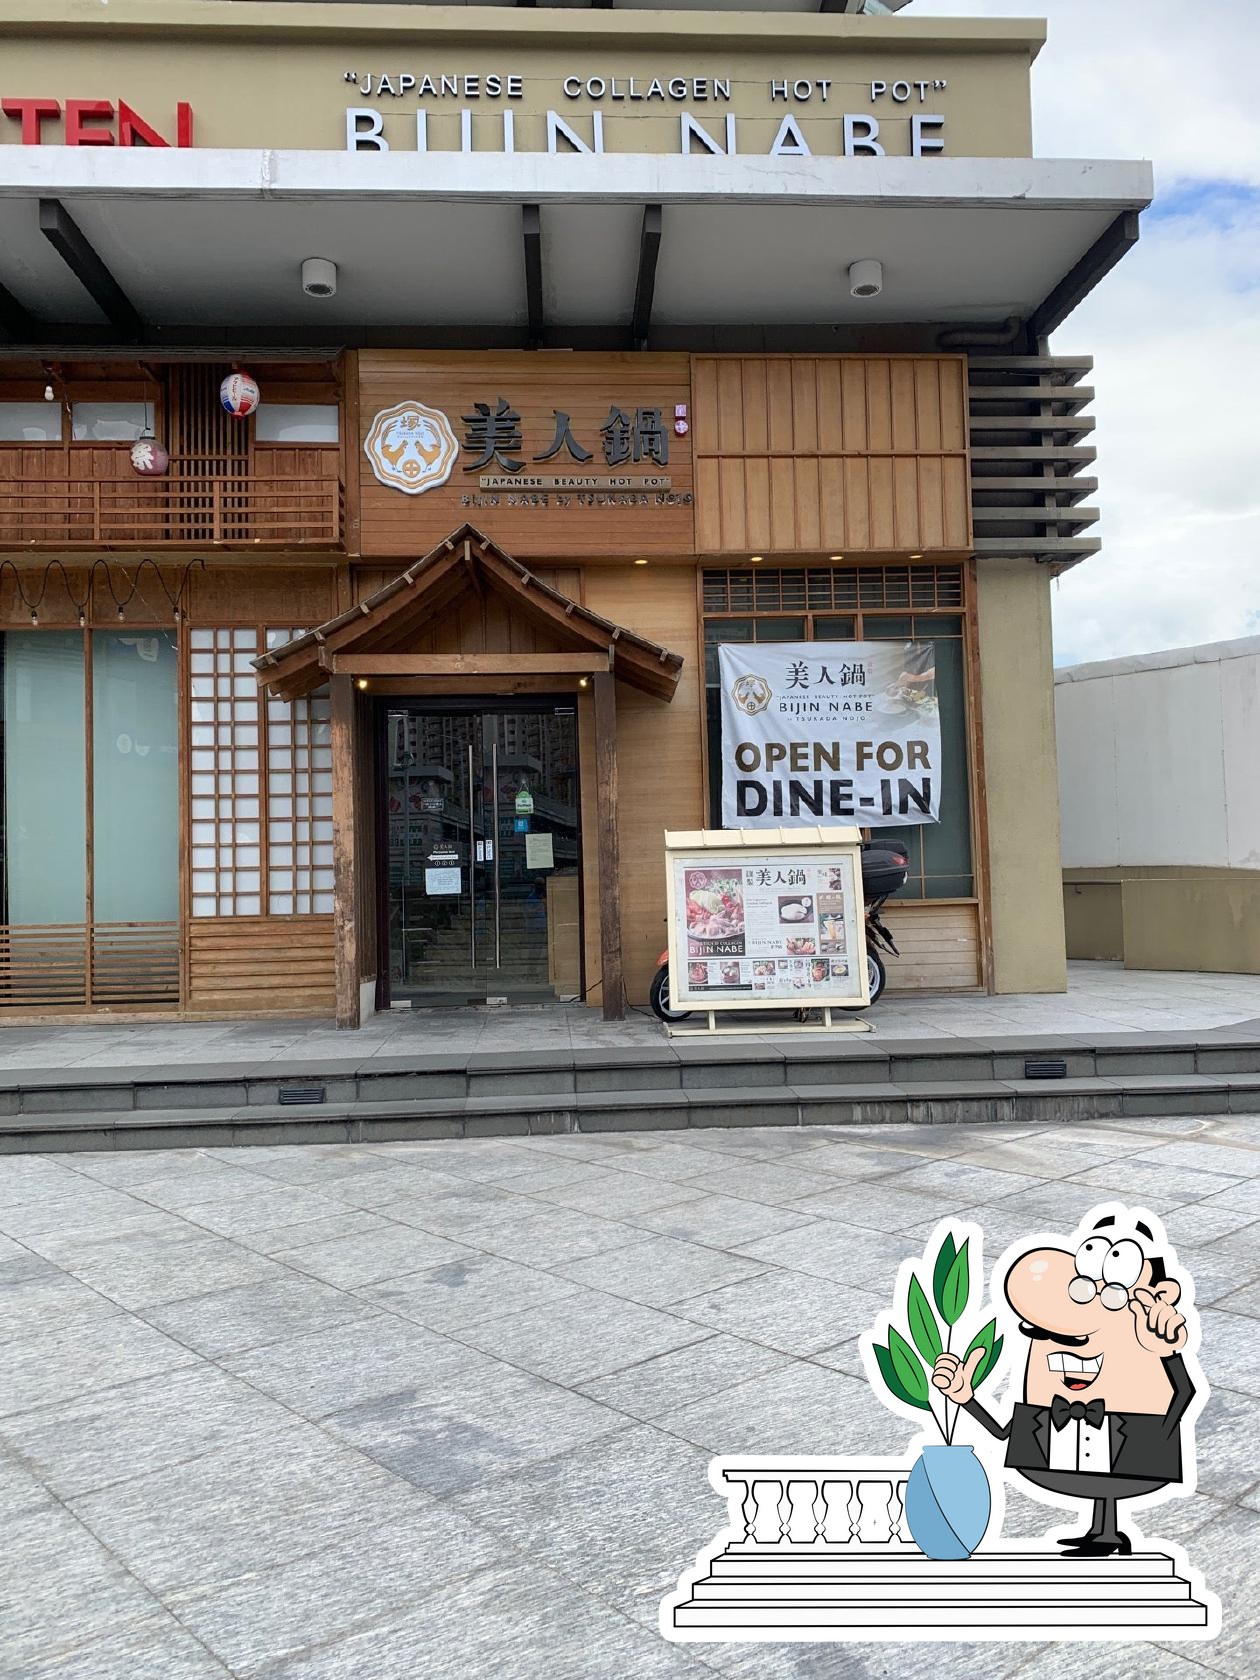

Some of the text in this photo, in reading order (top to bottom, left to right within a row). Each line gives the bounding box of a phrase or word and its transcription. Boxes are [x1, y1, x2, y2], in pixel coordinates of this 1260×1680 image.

[563, 76, 731, 100] COLLAGEN
[772, 79, 832, 102] HOT
[461, 397, 671, 474] 美人鍋
[554, 478, 598, 486] BEAUTY
[609, 478, 632, 486] HOT
[785, 660, 866, 689] 美人鍋
[780, 701, 873, 715] BIJIN NABE
[735, 740, 932, 773] OPEN FOR
[736, 777, 931, 817] DINE-IN
[756, 868, 806, 886] 美人鍋
[716, 945, 743, 953] NABE
